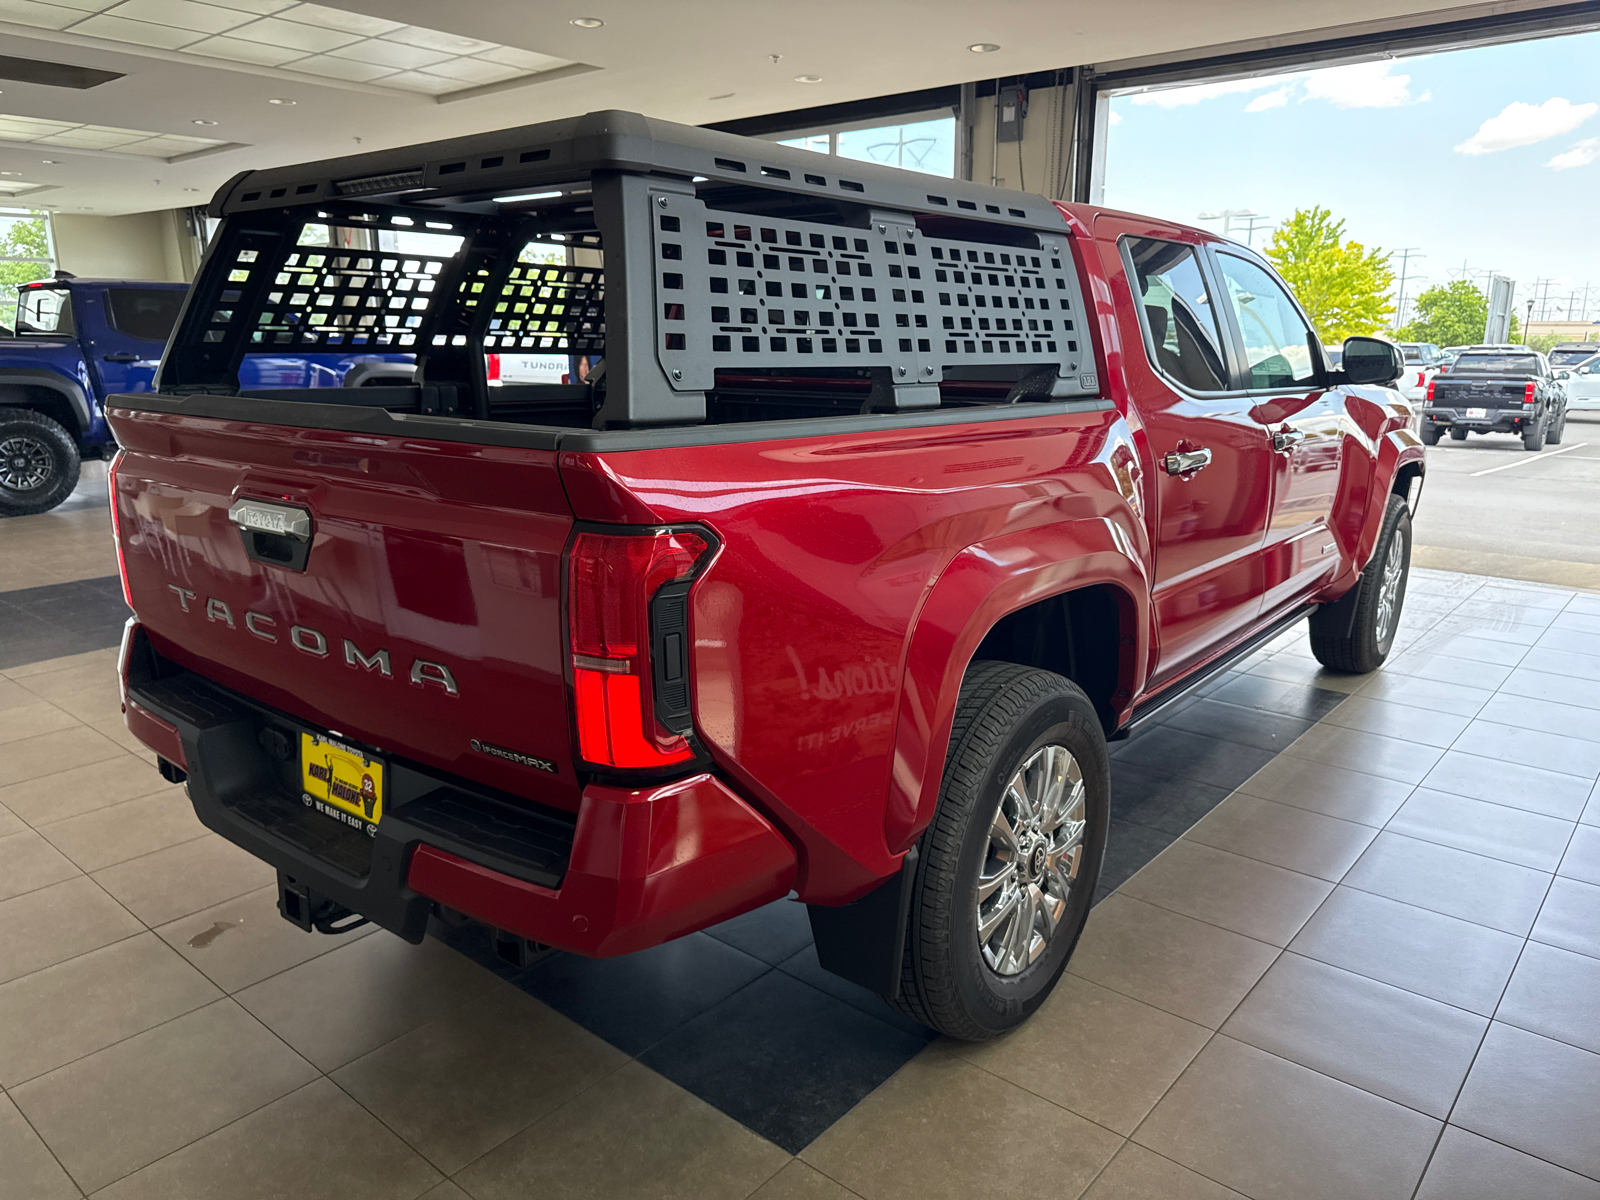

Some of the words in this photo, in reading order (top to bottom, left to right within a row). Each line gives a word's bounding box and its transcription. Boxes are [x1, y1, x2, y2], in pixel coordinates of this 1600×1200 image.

[247, 510, 285, 532] TOYOTA
[168, 583, 459, 697] TACOMA
[316, 733, 328, 744] KARL
[308, 762, 329, 782] KARL
[331, 781, 362, 808] MALONE
[363, 778, 373, 793] 32
[315, 800, 325, 813] WE
[325, 805, 340, 820] MAKE
[341, 813, 347, 823] IT
[347, 816, 362, 830] EASY
